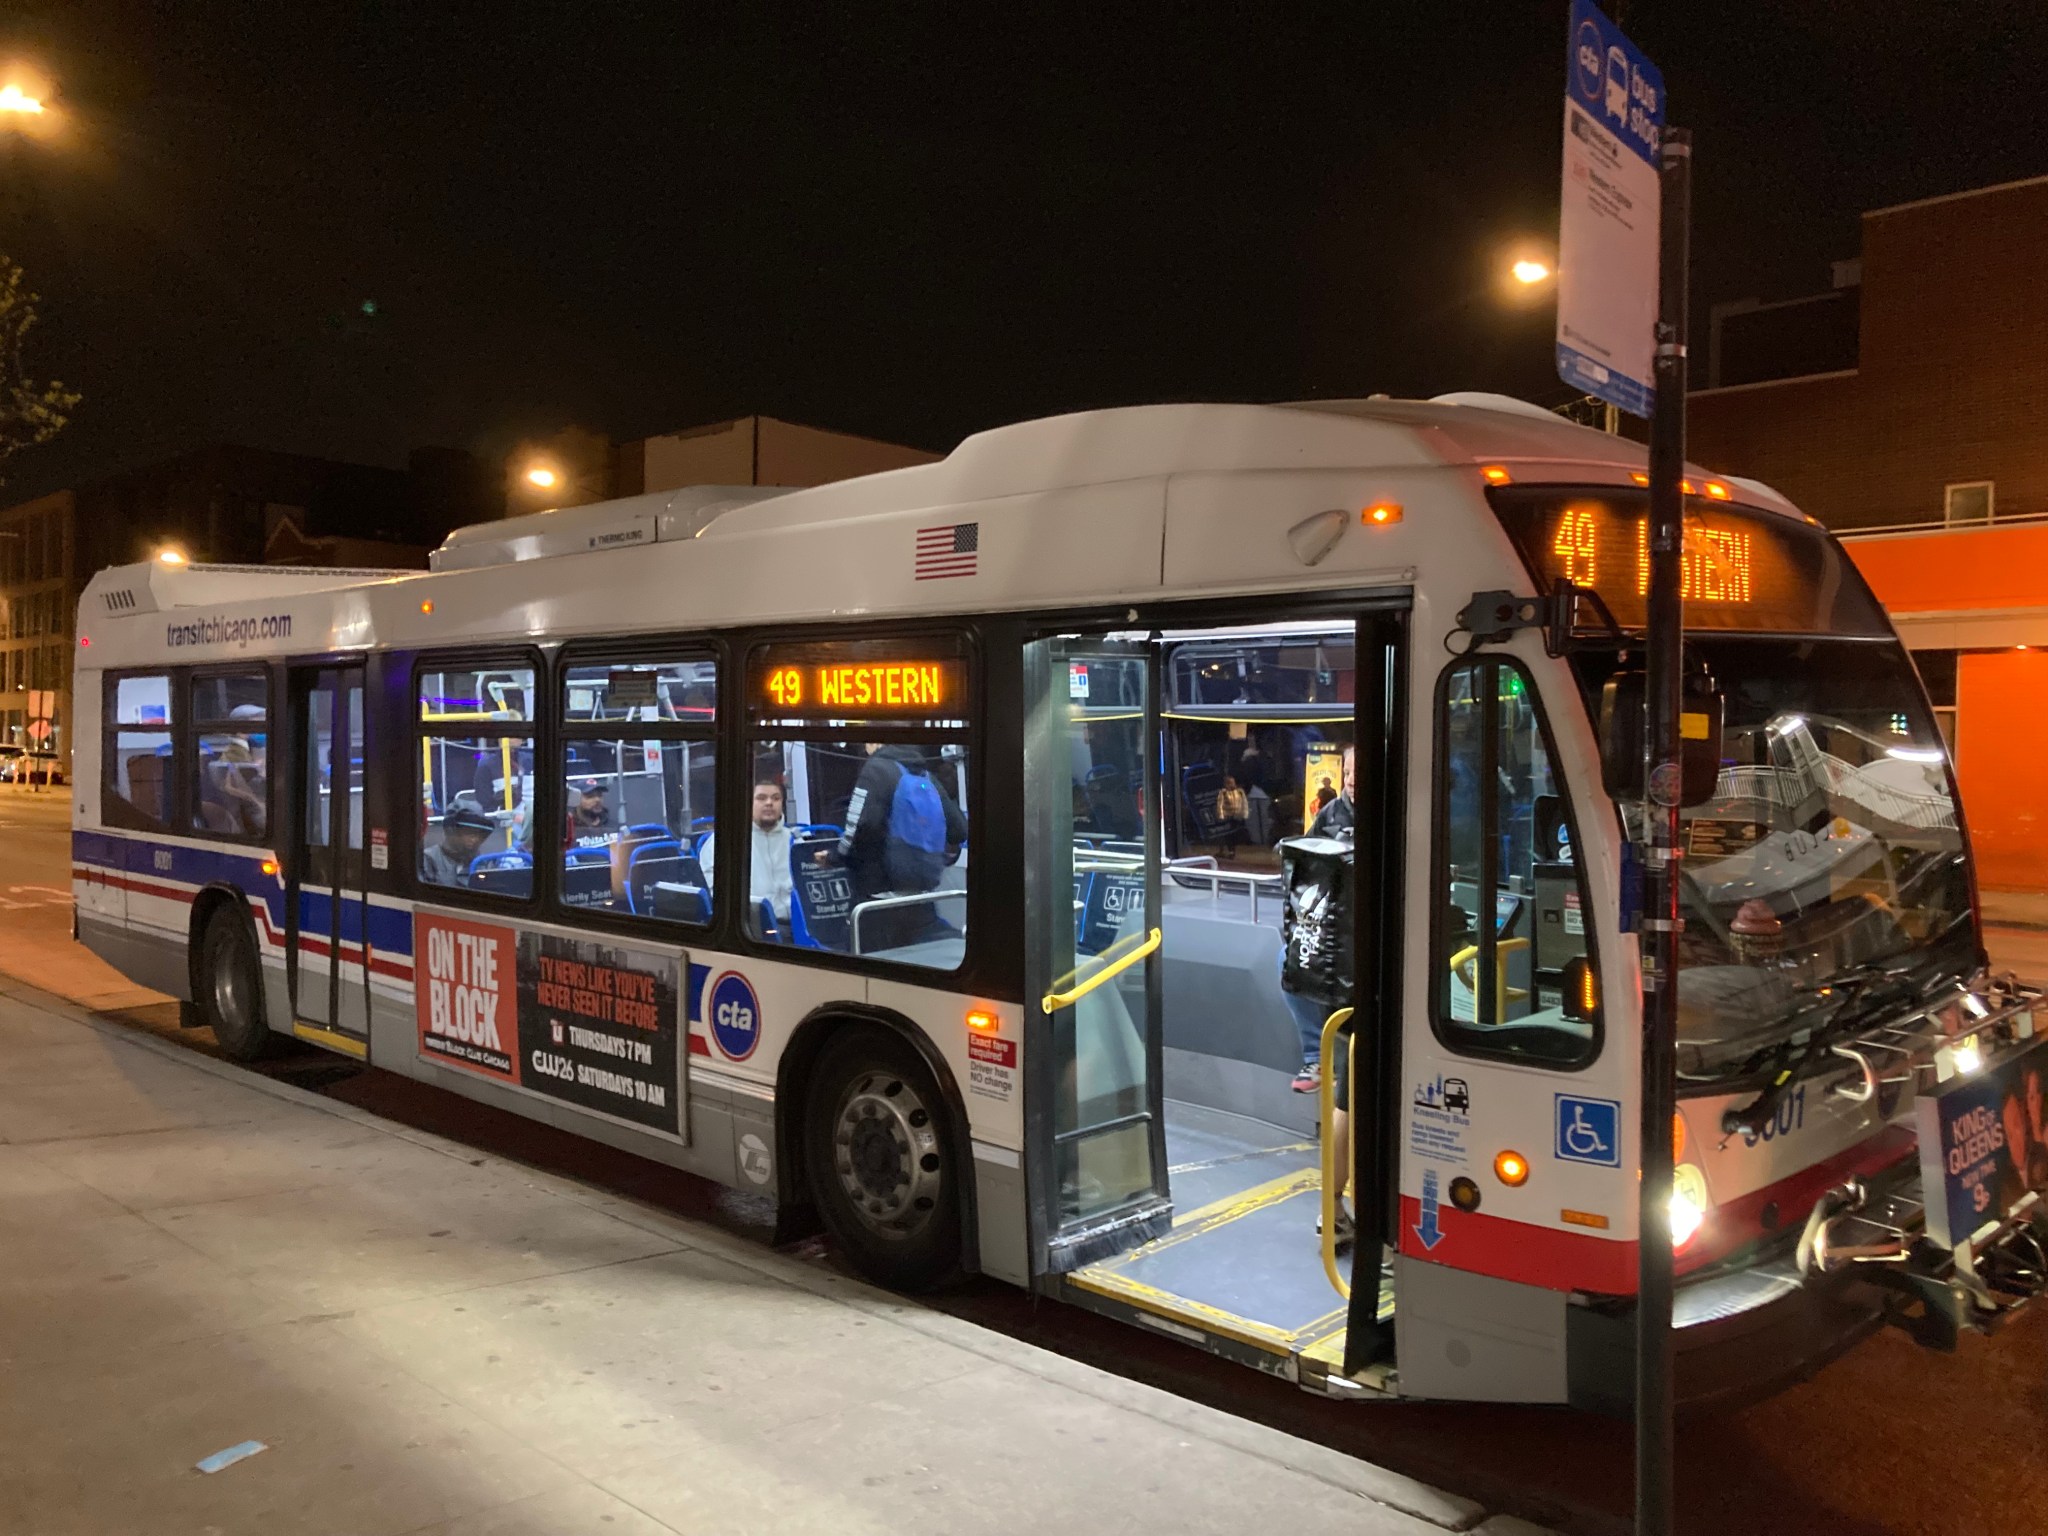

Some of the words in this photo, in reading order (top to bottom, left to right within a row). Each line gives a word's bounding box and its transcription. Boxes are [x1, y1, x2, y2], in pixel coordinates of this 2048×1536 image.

[1632, 64, 1656, 113] bus
[1630, 107, 1659, 156] stop
[1554, 511, 1595, 588] 49
[167, 614, 291, 648] transitchicago.com
[769, 670, 801, 704] 49
[821, 666, 940, 704] WESTERN
[428, 927, 455, 982] ON
[457, 932, 499, 992] THE
[539, 956, 554, 981] TV
[555, 959, 587, 987] NEWS
[588, 965, 613, 993] LIKE
[614, 970, 656, 1003] YOU'VE
[430, 978, 501, 1052] BLOCK
[537, 981, 571, 1010] NEVER
[572, 988, 600, 1017] SEEN
[601, 994, 613, 1019] IT
[615, 997, 659, 1032] BEFORE
[717, 1000, 753, 1031] cta
[568, 1025, 627, 1059] THURSDAYS
[626, 1040, 633, 1060] 7
[634, 1041, 653, 1065] PM
[970, 1034, 992, 1048] Exact
[992, 1039, 1009, 1053] fare
[970, 1047, 1003, 1062] required
[577, 1063, 634, 1098] SATURDAYS
[635, 1080, 647, 1102] 10
[647, 1083, 665, 1107] AM
[970, 1060, 993, 1075] Driver
[994, 1066, 1009, 1080] has
[970, 1071, 983, 1083] NO
[984, 1076, 1013, 1092] change
[1413, 1106, 1451, 1124] Kneeling
[1453, 1114, 1470, 1126] Bus
[1952, 1105, 1985, 1145] KING
[1949, 1122, 2003, 1175] QUEENS
